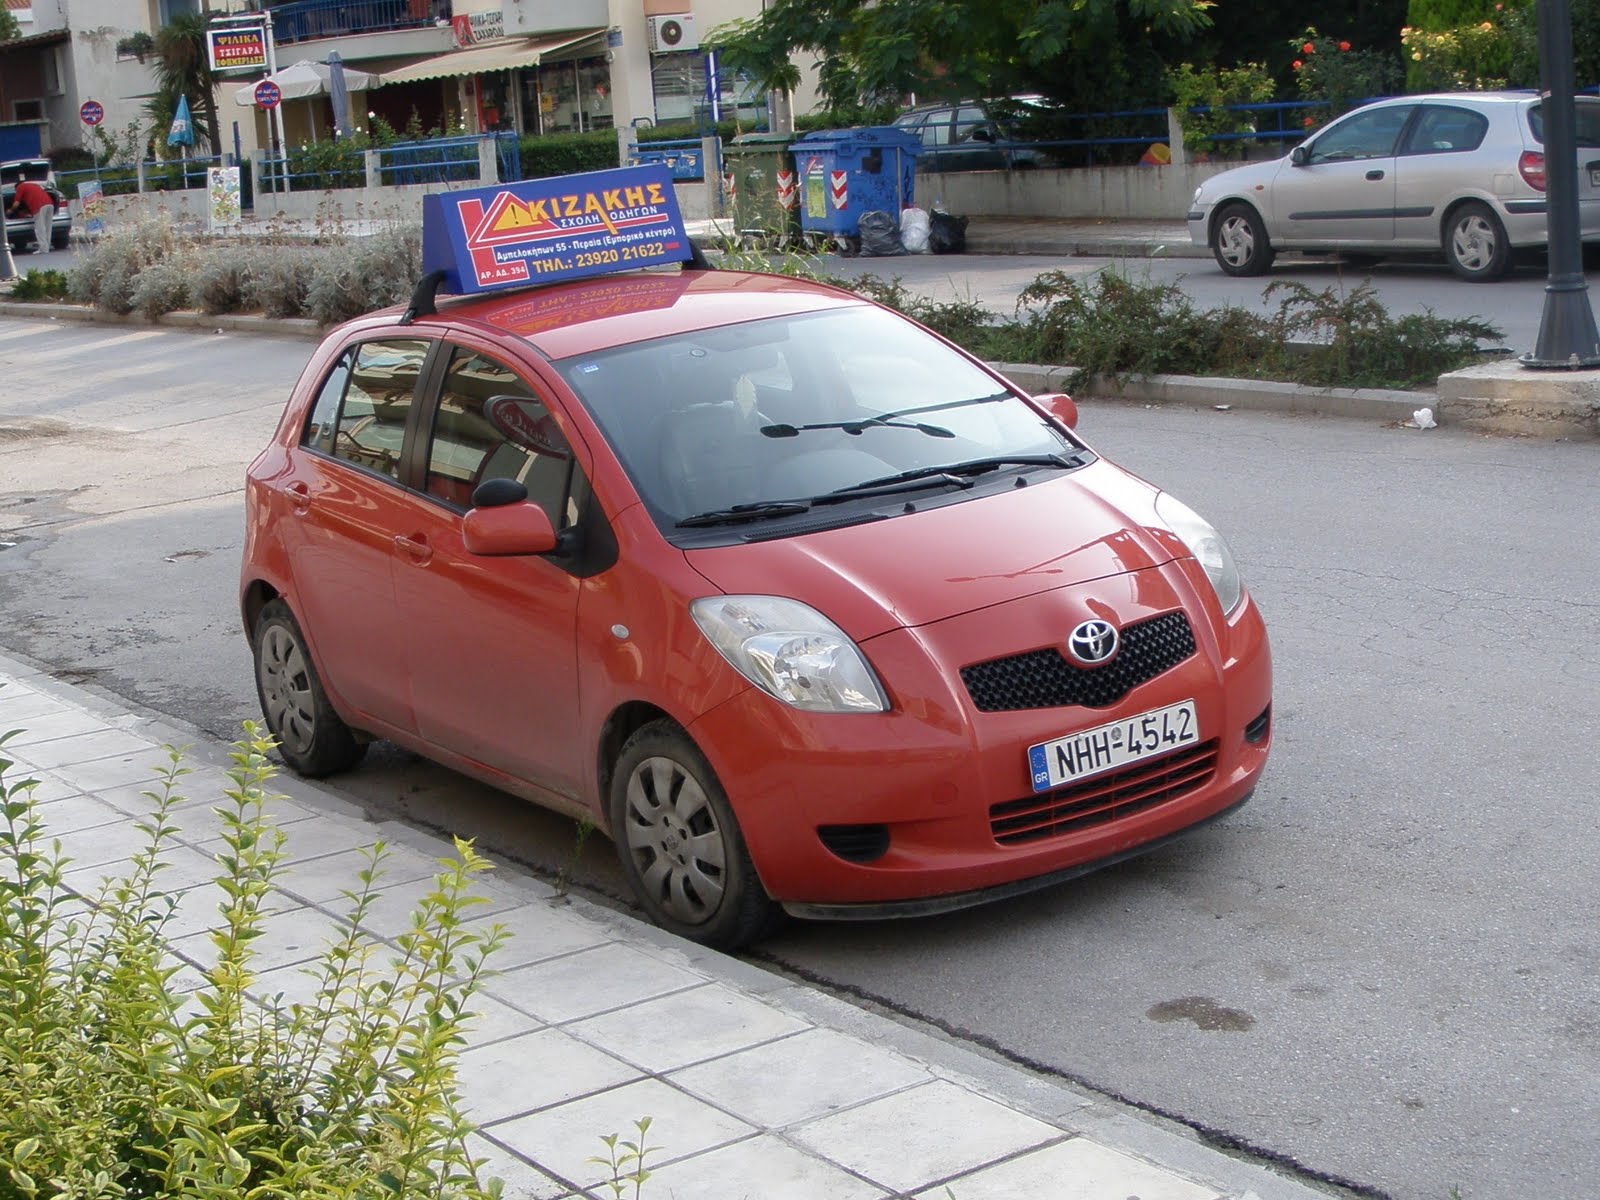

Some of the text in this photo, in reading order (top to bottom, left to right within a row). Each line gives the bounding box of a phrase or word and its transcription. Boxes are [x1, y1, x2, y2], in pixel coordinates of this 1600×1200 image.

[217, 34, 259, 45] ΨΙΛΙΚΑ
[219, 46, 260, 57] ΤΣΙΓΑΡΑ
[560, 205, 658, 228] ΣΧΟΛΗ ΟΔΗΓΩΝ
[496, 246, 554, 261] Αμπελοκήπων
[556, 243, 567, 252] 55
[572, 238, 602, 250] Περαία
[603, 231, 644, 247] (Εμπορικό
[645, 226, 676, 241] κέντρο)
[532, 242, 664, 273] ΤΗΛ.: 23920 21622
[480, 266, 526, 280] ΑΡ. ΑΔ. 394
[1056, 707, 1194, 779] NHH-4542
[1034, 773, 1049, 784] GR
